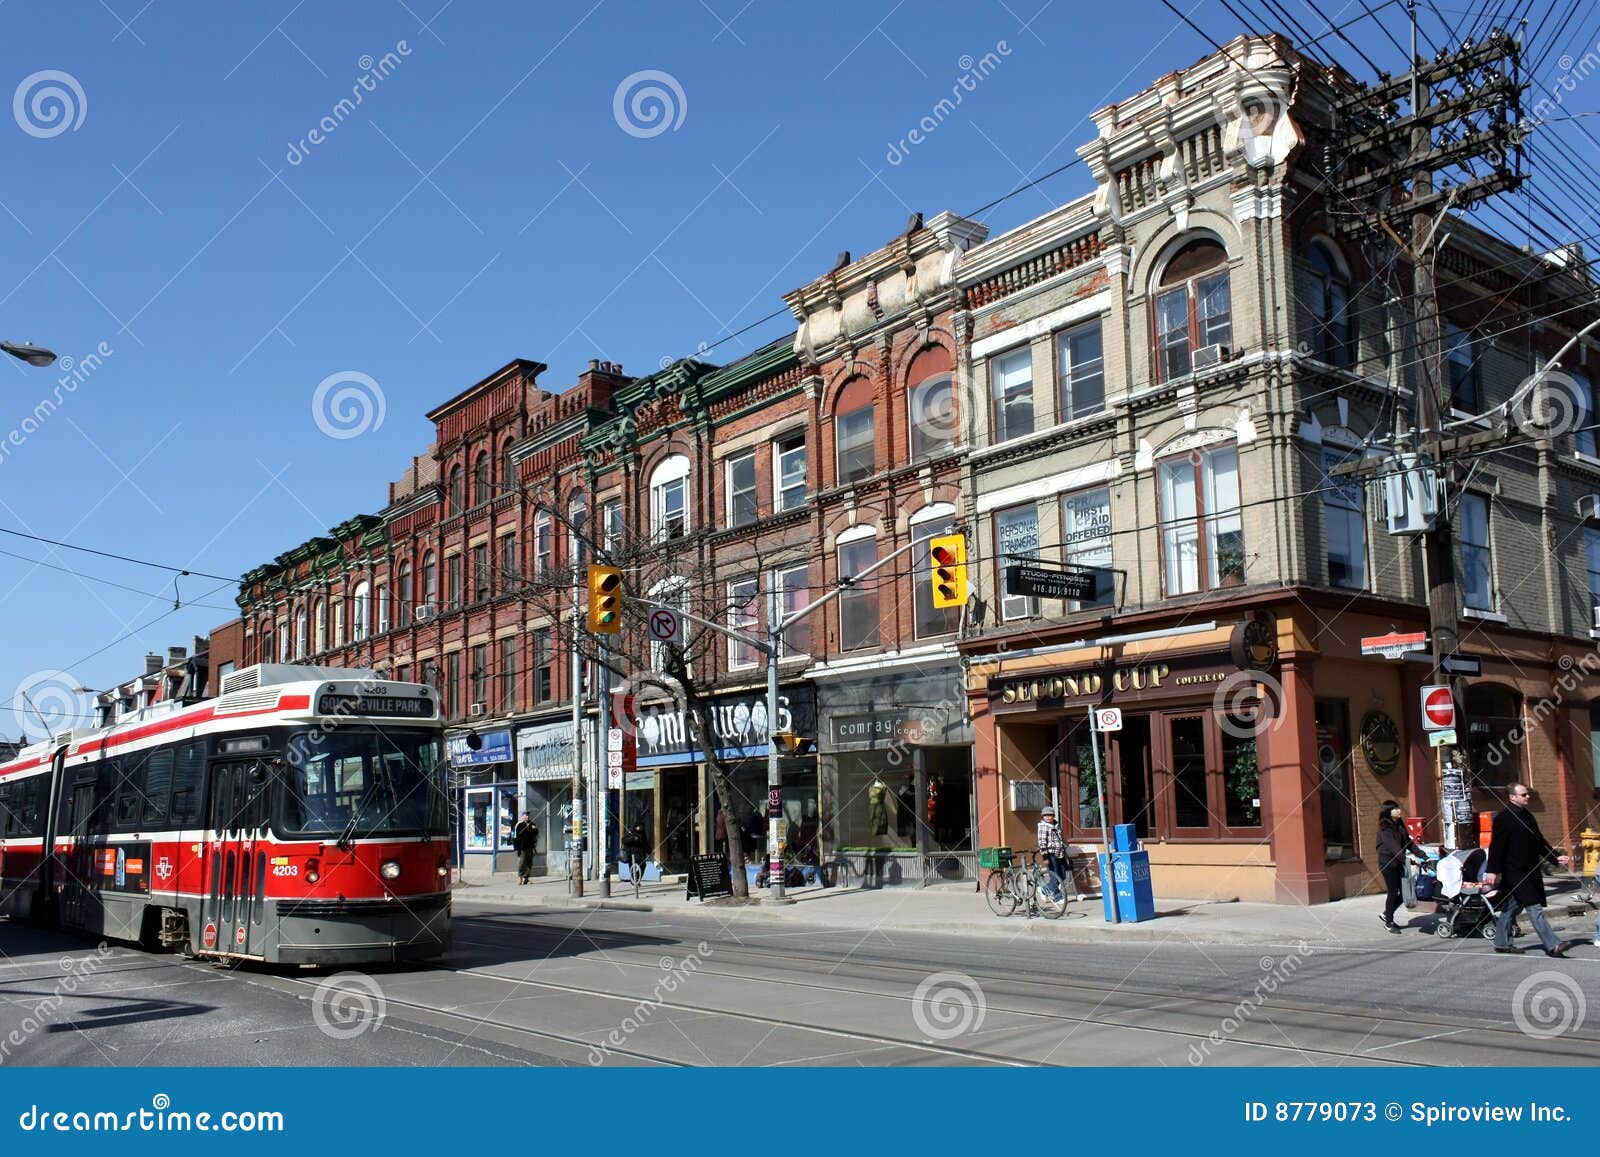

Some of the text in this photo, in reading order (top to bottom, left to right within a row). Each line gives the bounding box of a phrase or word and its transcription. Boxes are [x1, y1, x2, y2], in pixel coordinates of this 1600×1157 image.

[1075, 504, 1104, 519] FIRST
[1091, 514, 1109, 527] AID
[1065, 525, 1110, 543] OFFERED
[1002, 673, 1101, 704] SECOND
[1113, 664, 1169, 693] CUP
[396, 700, 421, 713] PARK
[840, 719, 902, 736] comrag
[272, 865, 298, 876] 4203
